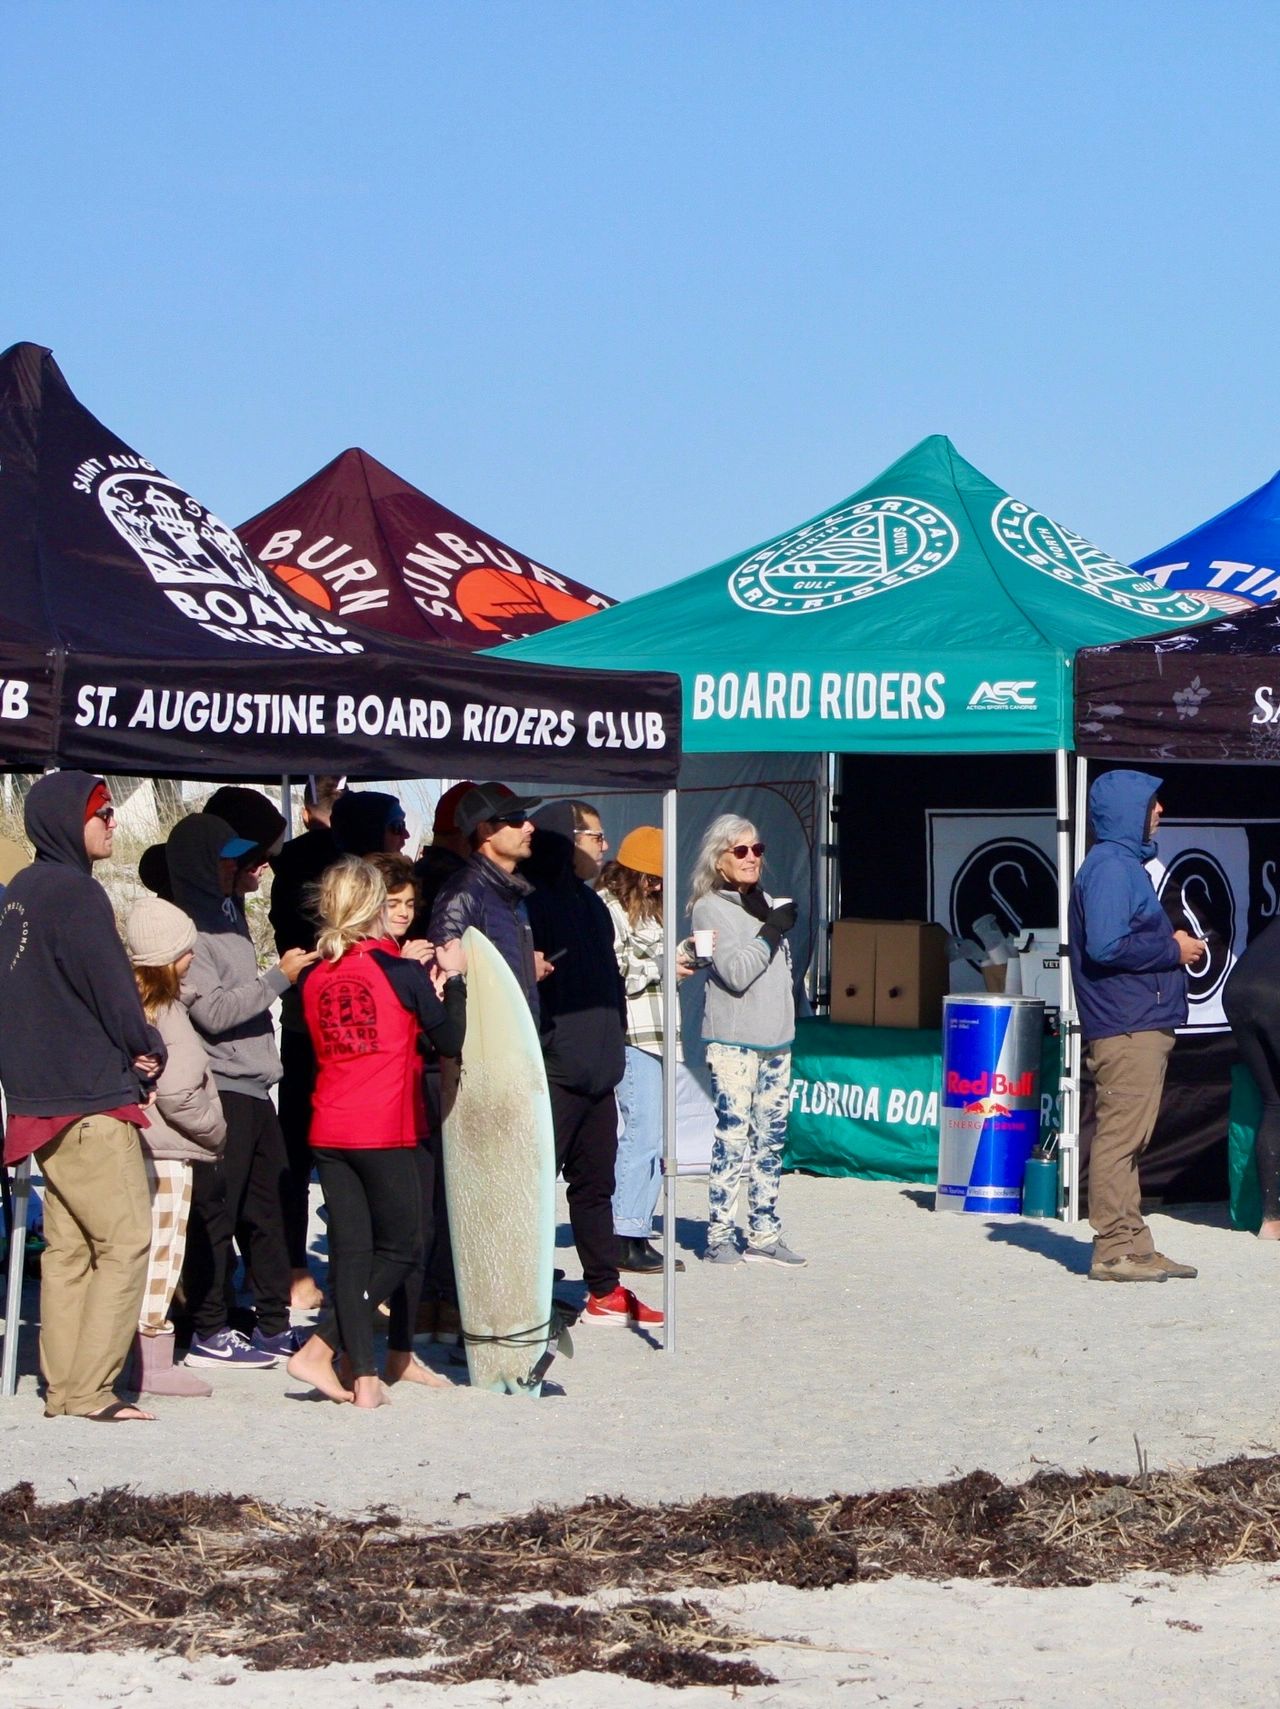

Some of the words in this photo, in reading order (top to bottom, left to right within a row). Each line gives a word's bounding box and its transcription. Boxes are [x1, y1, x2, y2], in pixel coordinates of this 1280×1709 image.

[73, 458, 107, 494] SAINT
[109, 454, 157, 473] AUG
[1002, 502, 1028, 540] FLO
[785, 526, 840, 557] NORTH
[893, 526, 908, 556] SOUTH
[1037, 527, 1067, 560] NORTH
[258, 529, 390, 616] BURN
[738, 550, 781, 608] BOARD
[802, 550, 943, 610] RIDERS
[793, 581, 836, 590] GULF
[1132, 581, 1163, 593] GUL
[693, 672, 811, 720] BOARD
[819, 672, 946, 720] RIDERS
[74, 684, 117, 728] ST.
[128, 689, 326, 734] AUGUSTINE
[336, 694, 451, 739] BOARD
[462, 703, 576, 747] RIDERS
[586, 711, 666, 750] CLUB
[1043, 960, 1060, 968] YET
[947, 1071, 988, 1095] Red
[992, 1071, 1034, 1097] Bull
[789, 1079, 879, 1122] FLORIDA
[886, 1089, 938, 1127] BOA
